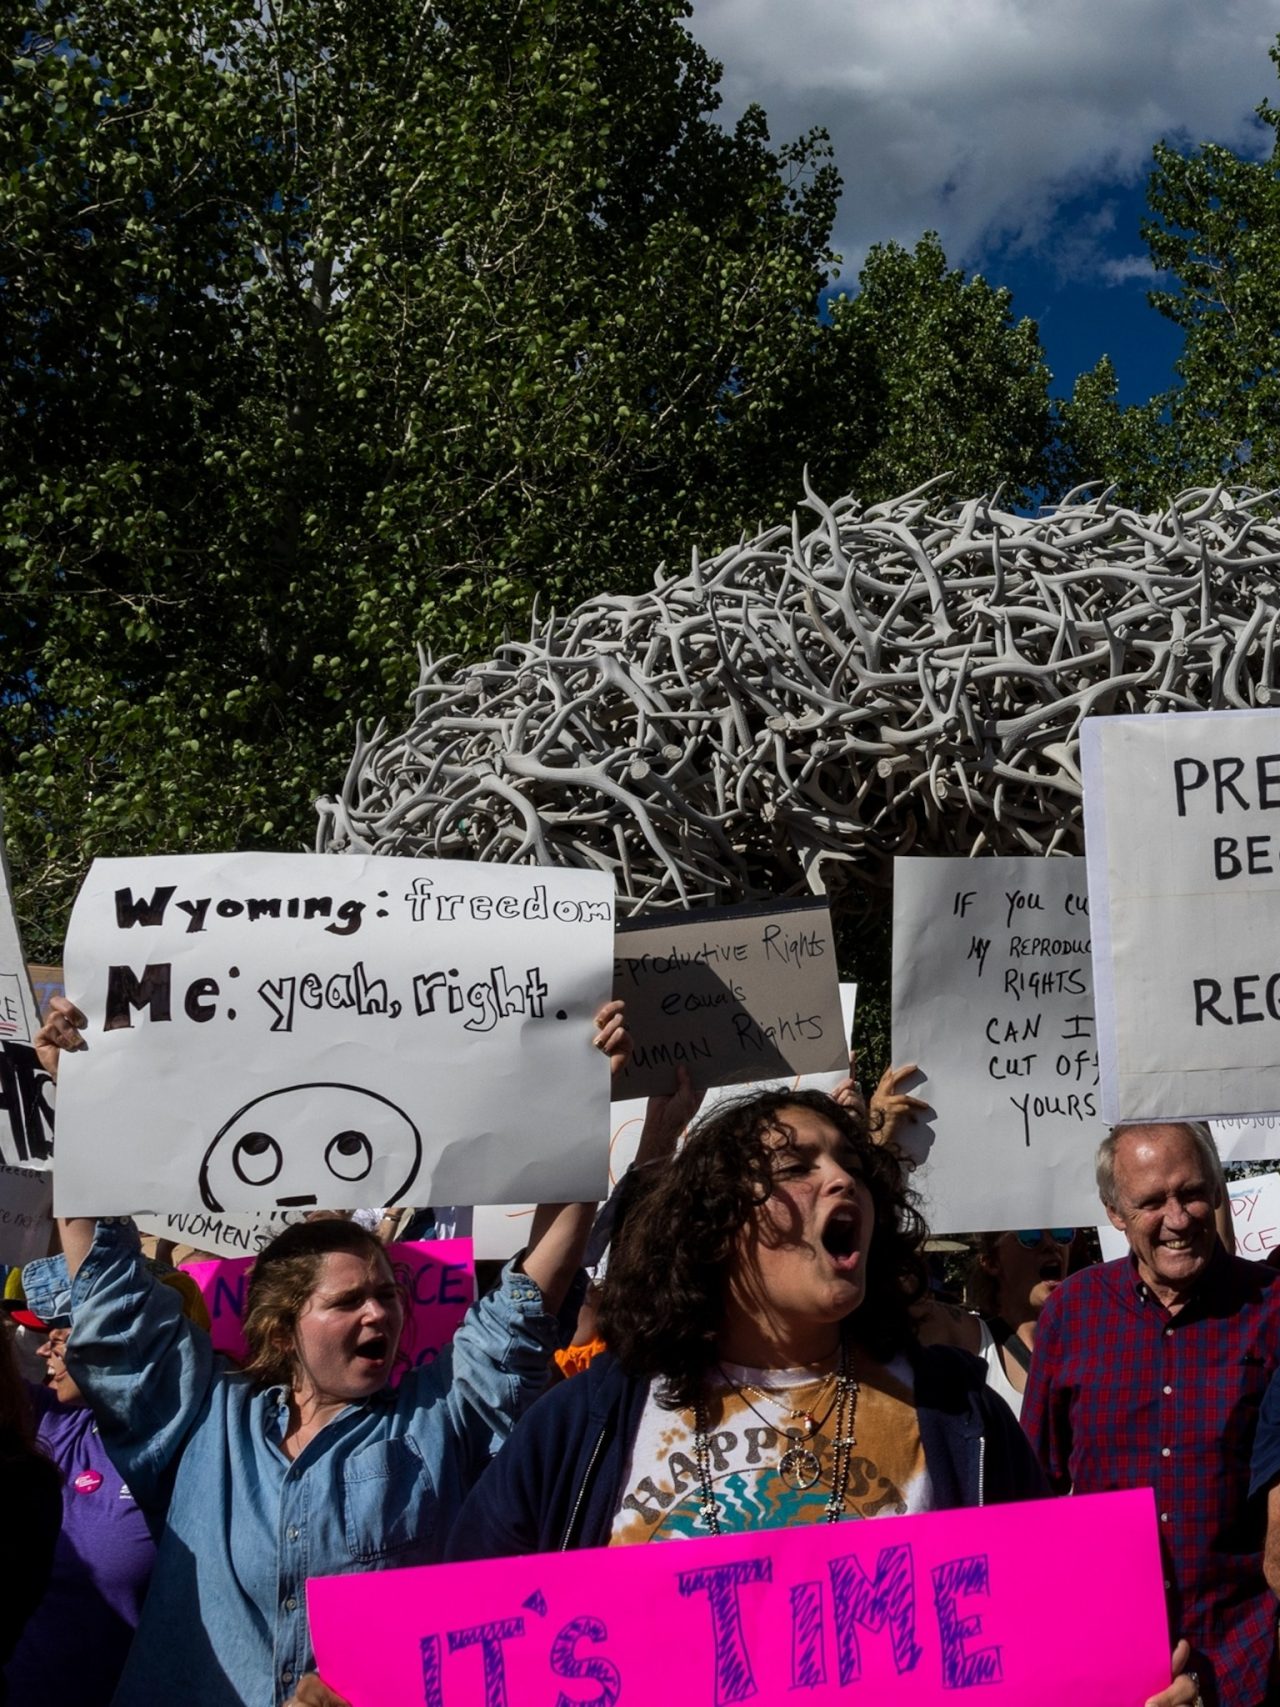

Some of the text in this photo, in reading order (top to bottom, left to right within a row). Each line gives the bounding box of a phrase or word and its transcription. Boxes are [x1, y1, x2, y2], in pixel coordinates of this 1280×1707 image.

[114, 878, 611, 936] Wyoming: freedom
[953, 891, 977, 918] IF
[102, 963, 240, 1032] Me:
[257, 961, 402, 1032] yeah,
[413, 966, 568, 1032] right.
[1004, 968, 1087, 1002] RIGHTS
[986, 1013, 1042, 1045] CAN
[1009, 1092, 1096, 1147] YOURS
[419, 1542, 1004, 1707] IT'S TIME
